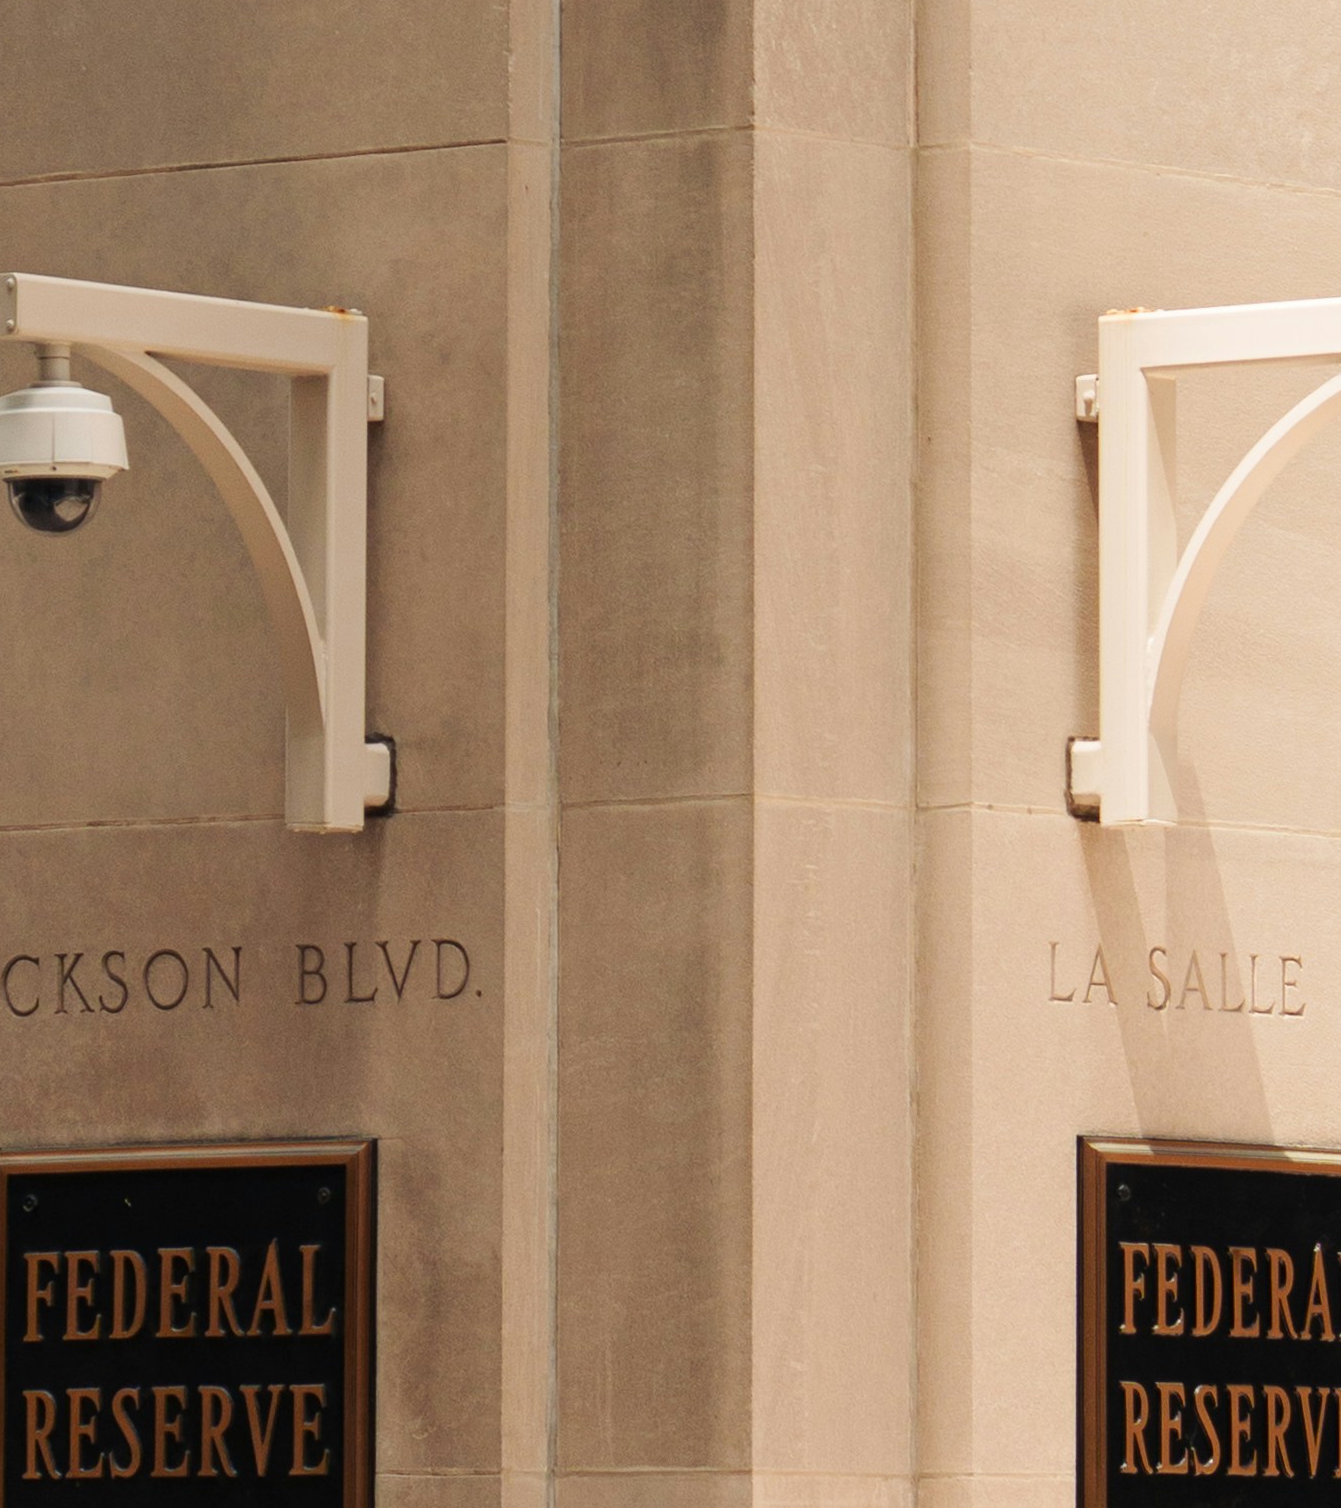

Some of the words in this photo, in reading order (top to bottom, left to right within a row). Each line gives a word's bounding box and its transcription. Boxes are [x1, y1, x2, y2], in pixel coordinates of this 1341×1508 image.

[294, 938, 483, 1006] BLVD.
[1048, 940, 1119, 1007] LA
[1145, 945, 1308, 1018] SALLE
[23, 1239, 336, 1342] FEDERAL
[22, 1382, 330, 1480] RESERVE
